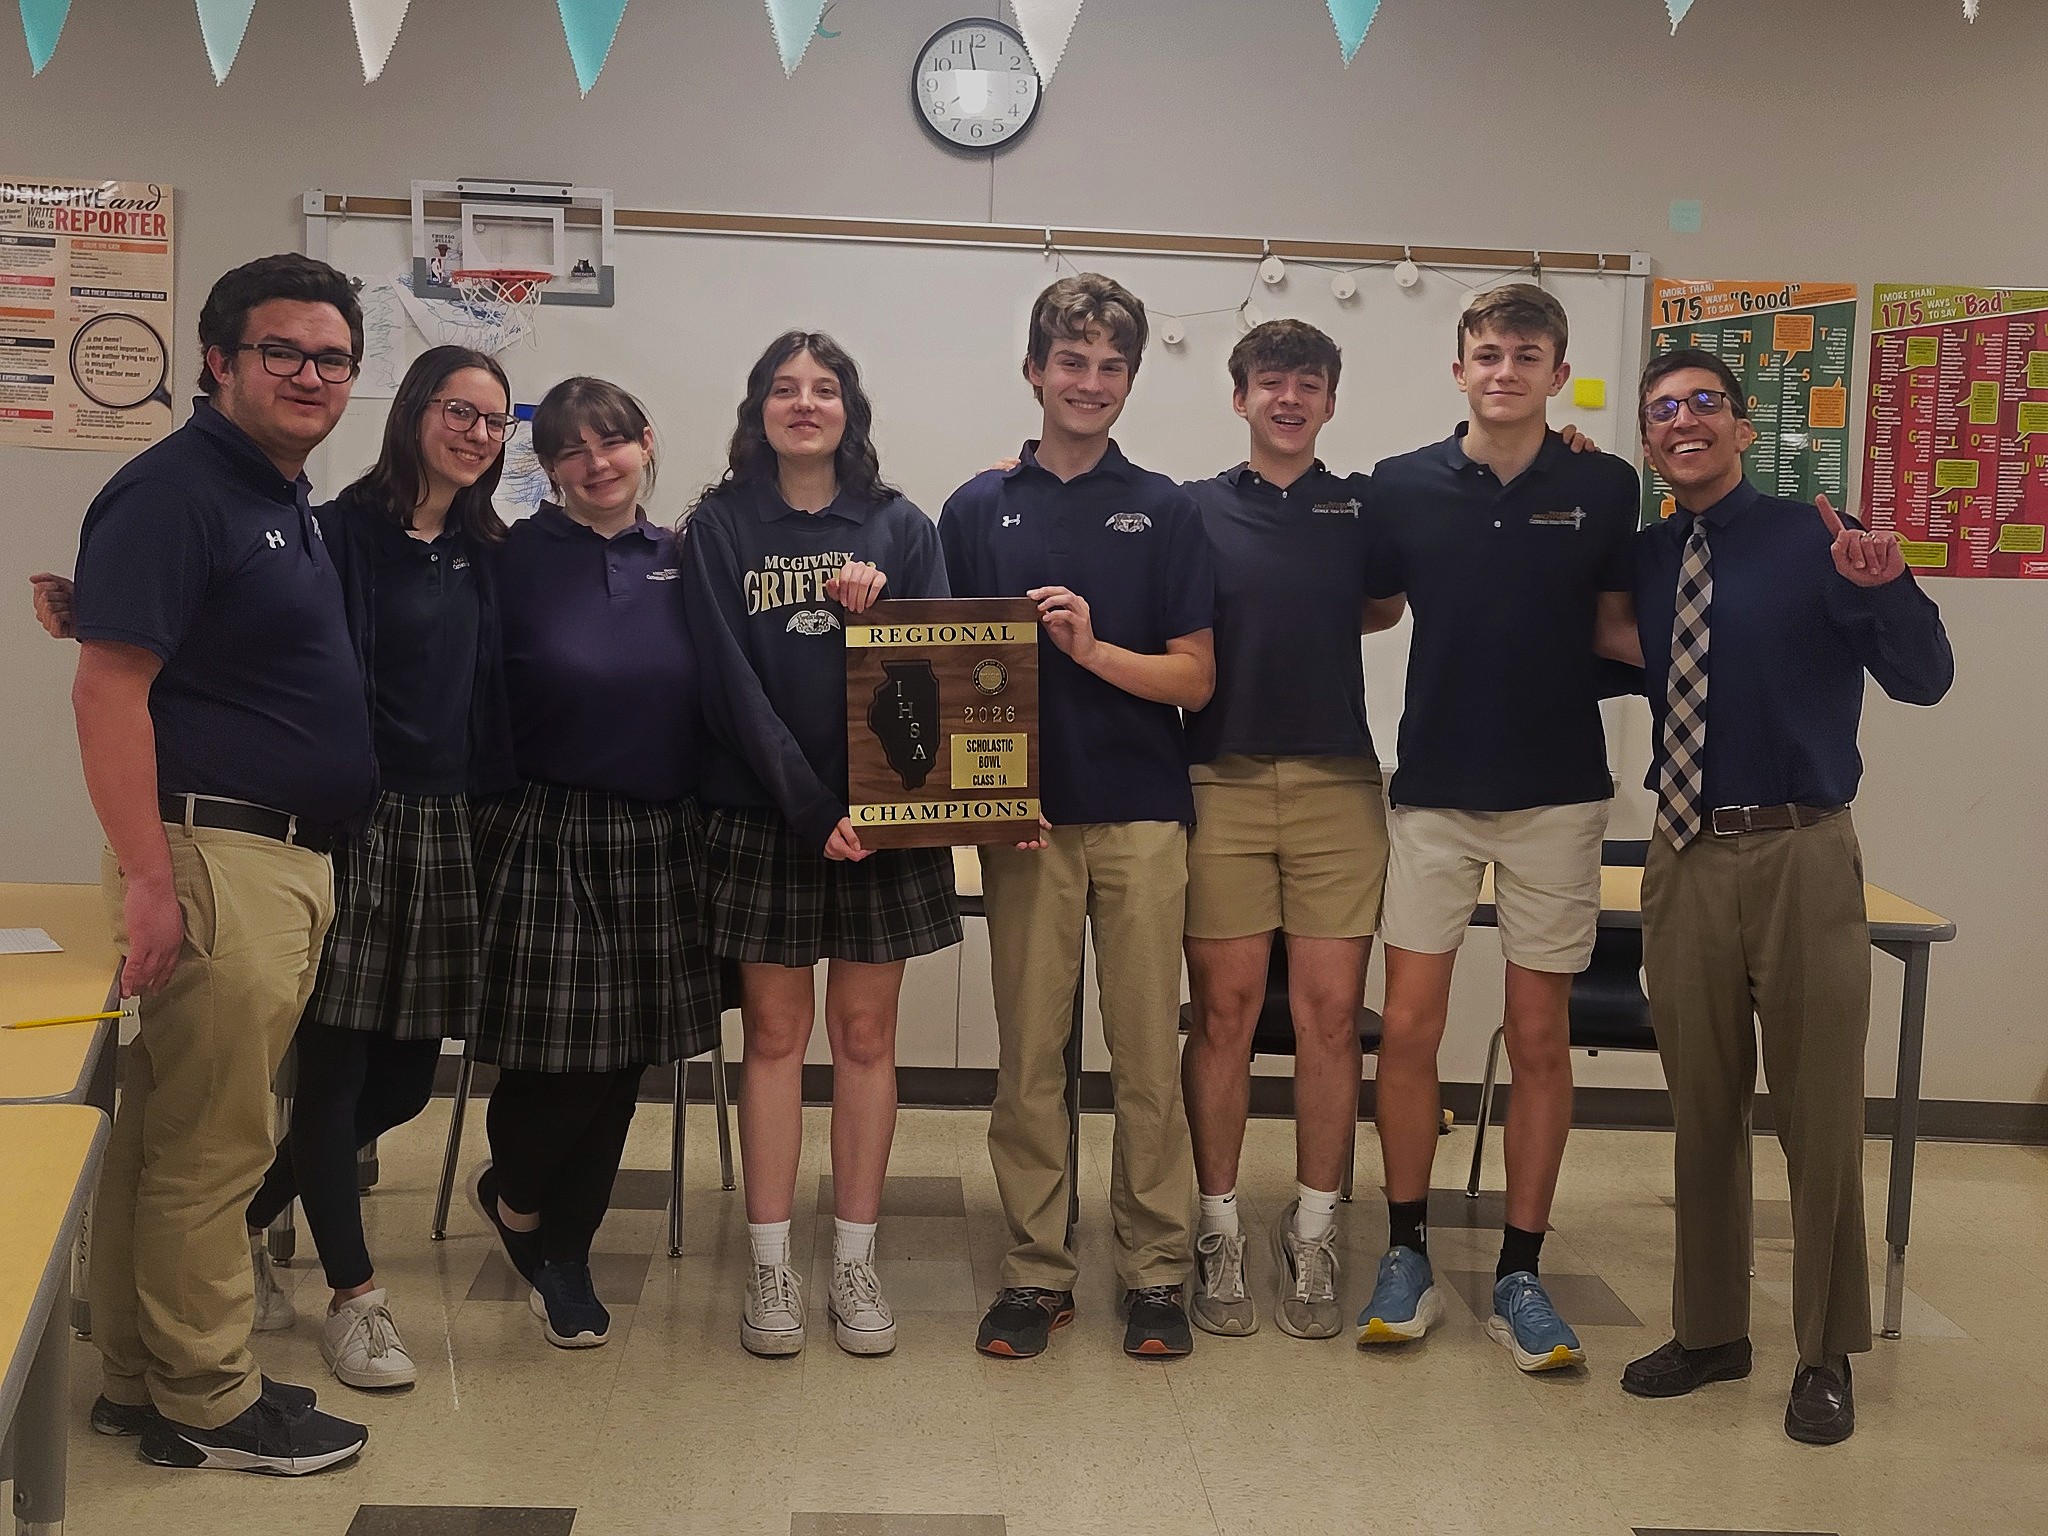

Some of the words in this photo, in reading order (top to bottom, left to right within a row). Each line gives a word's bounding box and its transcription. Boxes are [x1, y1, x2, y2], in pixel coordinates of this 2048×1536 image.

[952, 40, 962, 54] 11
[970, 34, 986, 48] 12
[999, 41, 1003, 55] 1
[934, 58, 952, 72] 10
[1010, 56, 1021, 70] 2
[926, 78, 938, 92] 9
[1016, 80, 1028, 94] 3
[933, 101, 945, 115] 8
[1008, 104, 1020, 117] 4
[951, 118, 962, 132] 7
[970, 124, 982, 138] 6
[992, 119, 1004, 132] 5
[108, 184, 168, 211] and
[28, 207, 55, 218] WRITE
[28, 216, 45, 229] like
[48, 220, 54, 229] a
[55, 208, 166, 236] REPORTER
[1705, 294, 1727, 304] WAYS
[1730, 284, 1800, 312] "Good"
[1927, 299, 1950, 308] WAYS
[1955, 291, 2012, 316] "Bad"
[1661, 296, 1703, 324] 175
[1706, 306, 1718, 315] TO
[1718, 304, 1735, 314] SAY
[1881, 300, 1923, 327] 175
[1928, 310, 1940, 320] TO
[1941, 308, 1957, 318] SAY
[1820, 328, 1828, 340] T
[1876, 335, 1885, 348] A
[1760, 354, 1768, 366] N
[1910, 374, 1918, 386] E
[1910, 396, 1918, 408] F
[1909, 430, 1917, 442] G
[1970, 434, 1980, 446] O
[2022, 440, 2030, 452] T
[1904, 471, 1914, 484] H
[1964, 496, 1973, 508] P
[1960, 527, 1969, 540] R
[743, 562, 876, 616] GRIFF
[869, 626, 1015, 644] REGIONAL
[964, 706, 1016, 724] 2026
[966, 739, 1014, 752] SCHOLASTIC
[978, 756, 1001, 769] BOWL
[972, 774, 994, 786] CLASS
[998, 774, 1007, 786] 1A
[860, 801, 1028, 822] CHAMPIONS
